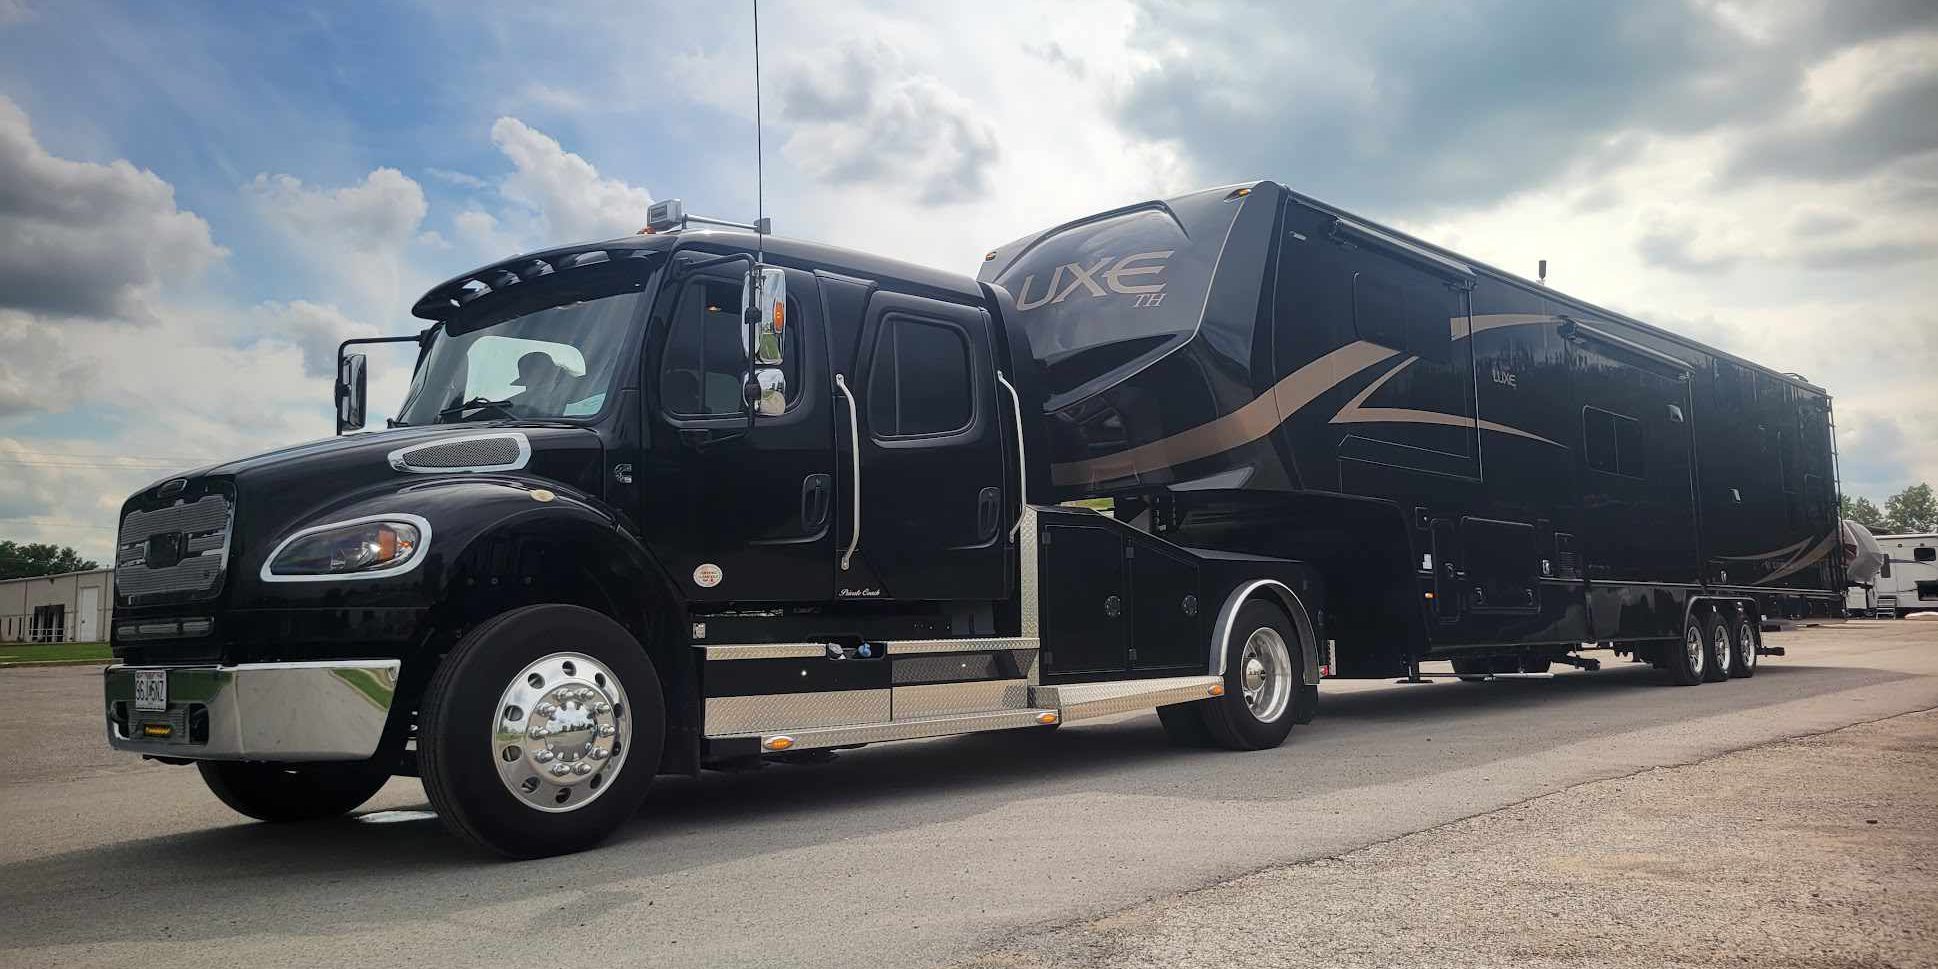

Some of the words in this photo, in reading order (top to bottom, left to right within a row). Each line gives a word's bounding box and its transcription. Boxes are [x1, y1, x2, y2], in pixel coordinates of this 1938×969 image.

[1016, 250, 1175, 311] UXE
[1133, 293, 1166, 308] TH
[1492, 368, 1517, 387] LUXE
